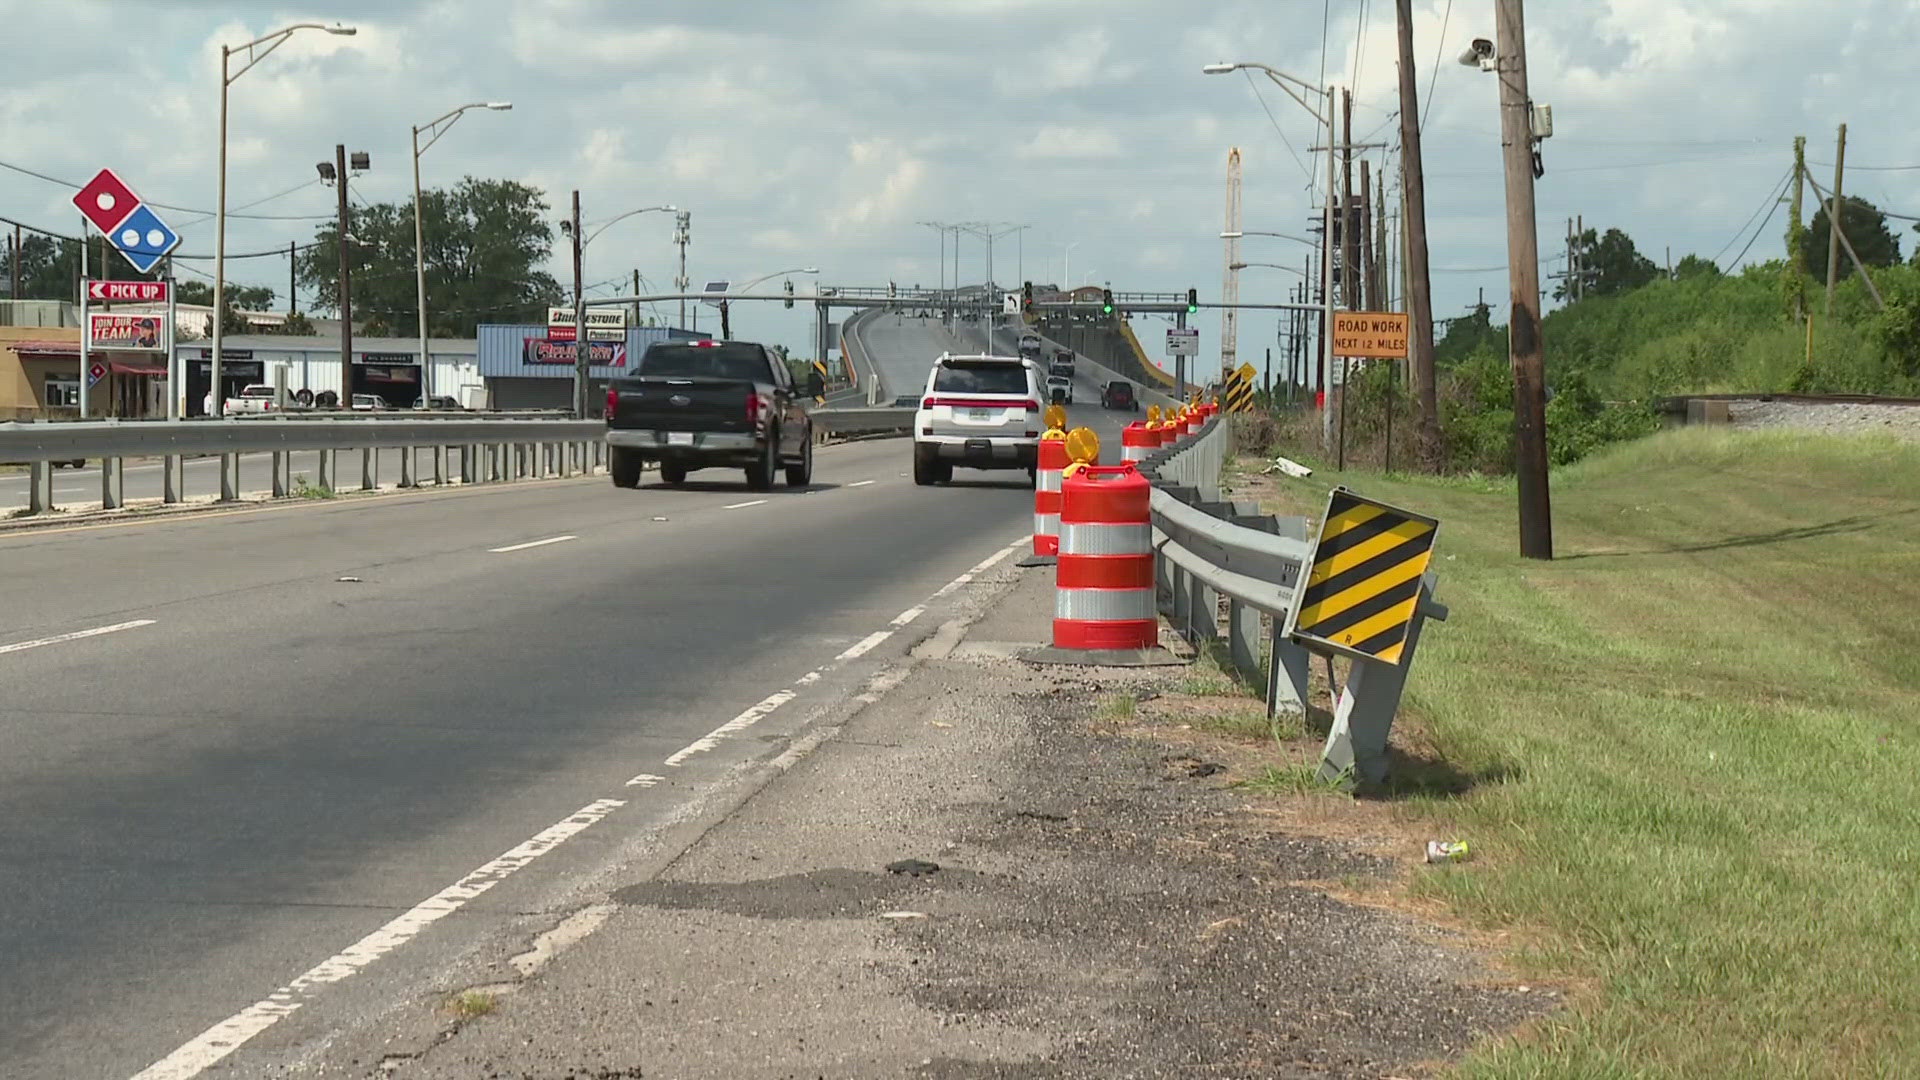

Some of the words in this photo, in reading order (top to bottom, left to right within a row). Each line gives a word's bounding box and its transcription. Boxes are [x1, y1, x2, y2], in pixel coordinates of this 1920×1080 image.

[109, 284, 139, 299] PICK
[142, 285, 159, 299] UP
[94, 318, 113, 328] JOIN
[114, 317, 132, 328] OUR
[1338, 320, 1368, 332] ROAD
[1372, 321, 1403, 333] WORK
[94, 327, 132, 340] TEAM
[1335, 338, 1358, 349] NEXT
[1362, 341, 1373, 349] 12
[1377, 339, 1405, 350] MILES
[1344, 634, 1353, 645] R
